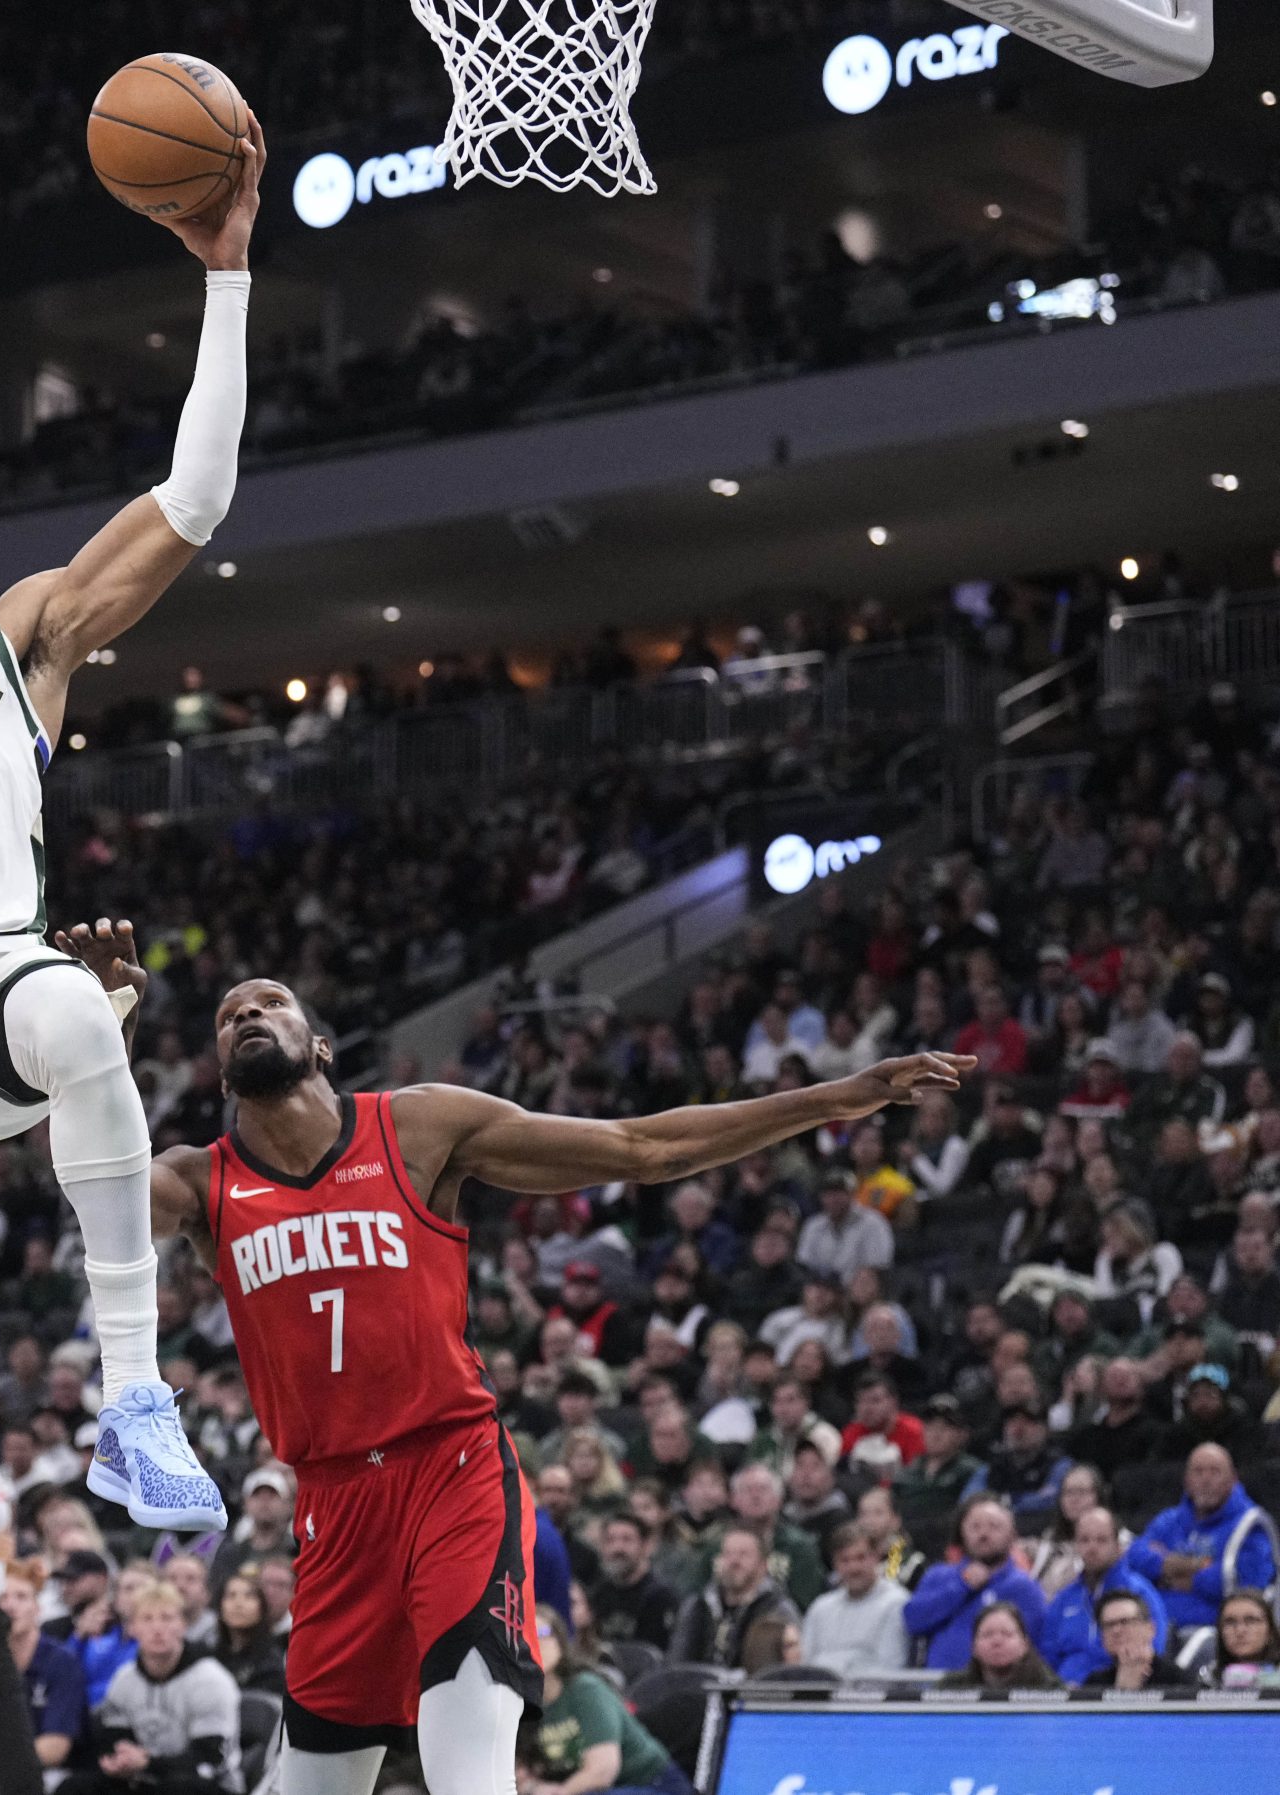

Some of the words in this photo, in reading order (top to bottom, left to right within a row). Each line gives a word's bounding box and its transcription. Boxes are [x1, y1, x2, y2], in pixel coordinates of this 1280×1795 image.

[895, 23, 1011, 87] razr
[969, 0, 1137, 70] CKS.COM
[230, 1211, 409, 1296] ROCKETS
[309, 1288, 345, 1373] 7
